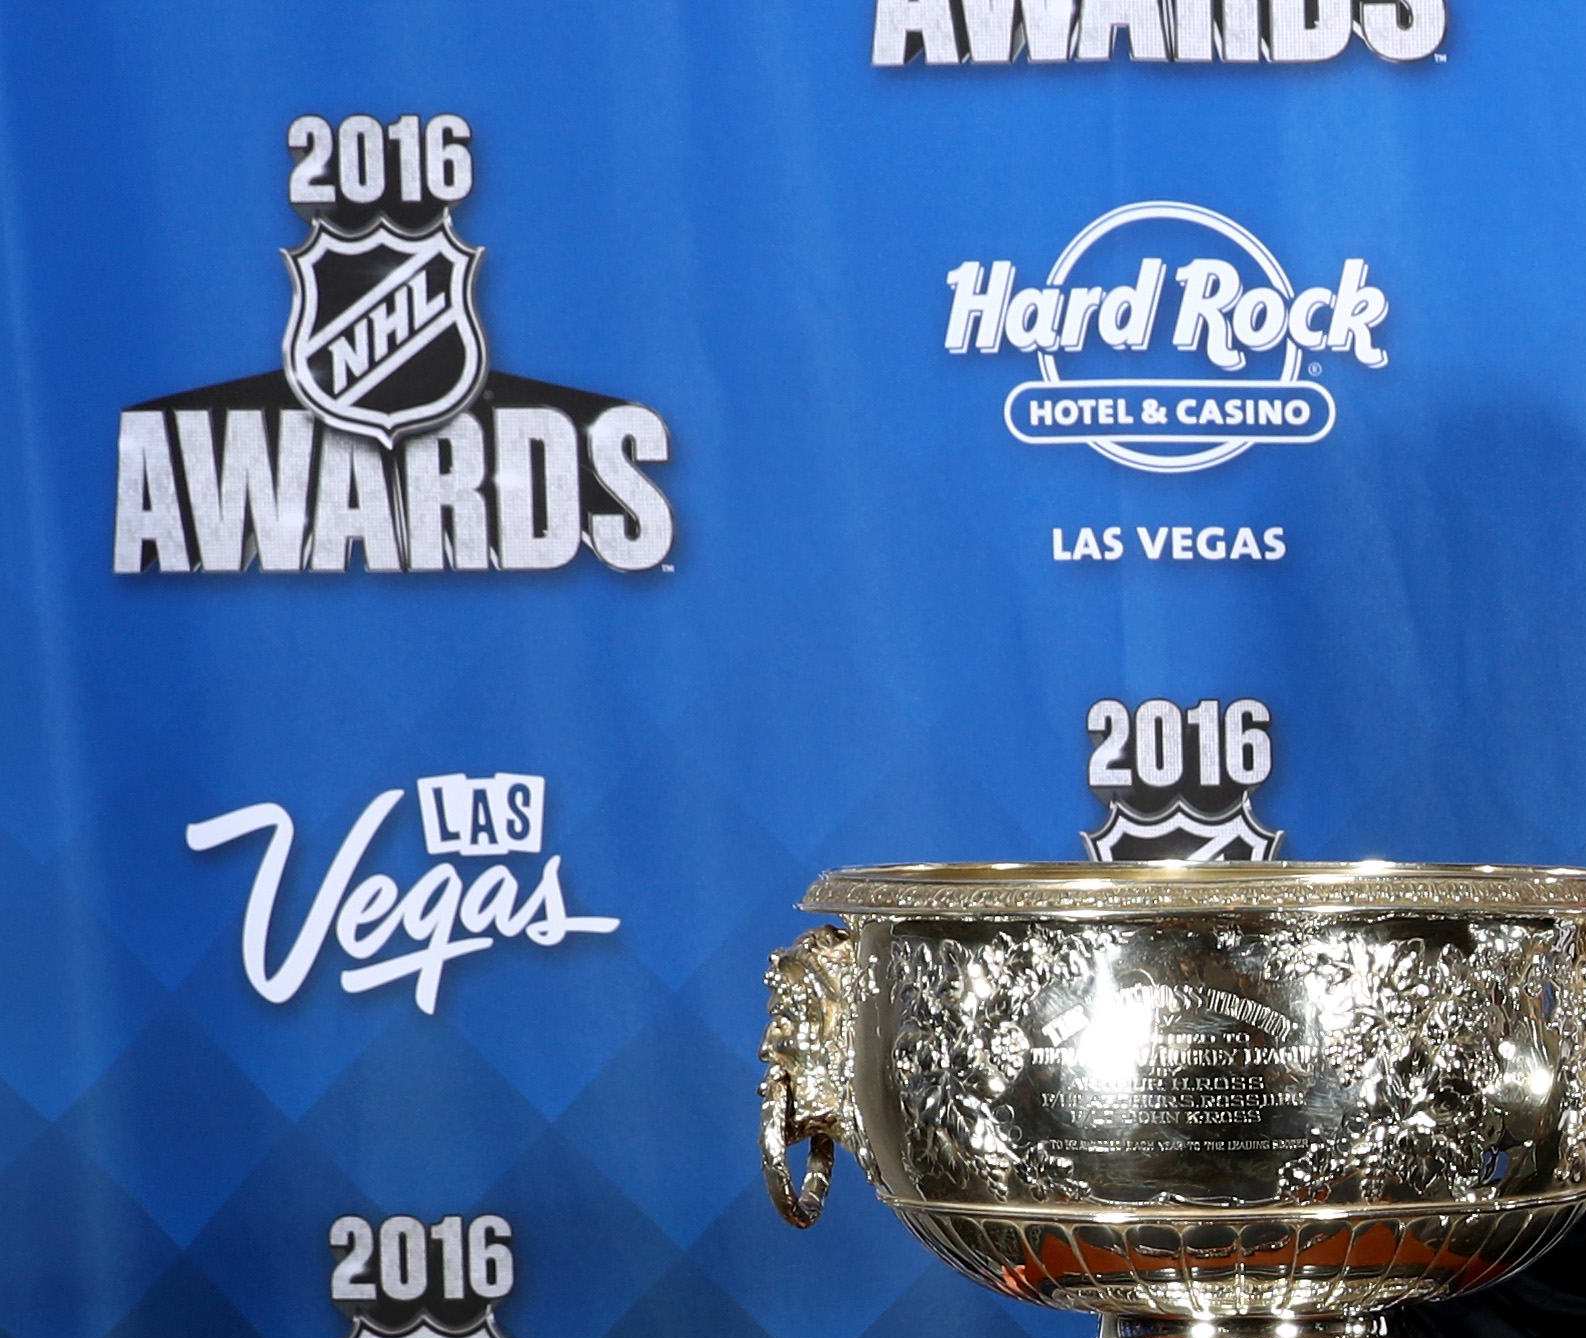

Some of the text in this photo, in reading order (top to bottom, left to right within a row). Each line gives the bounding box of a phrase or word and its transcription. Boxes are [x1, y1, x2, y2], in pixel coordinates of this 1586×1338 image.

[288, 114, 472, 203] 2016
[331, 268, 452, 394] NHL
[945, 258, 1389, 371] Hard Rock
[1028, 398, 1311, 426] HOTEL & CASINO
[114, 402, 674, 572] AWARDS
[1052, 526, 1287, 561] LAS VEGAS
[1087, 699, 1272, 787] 2016
[431, 783, 531, 847] LAS
[186, 789, 620, 1014] Vegas
[330, 1216, 514, 1301] 2016
